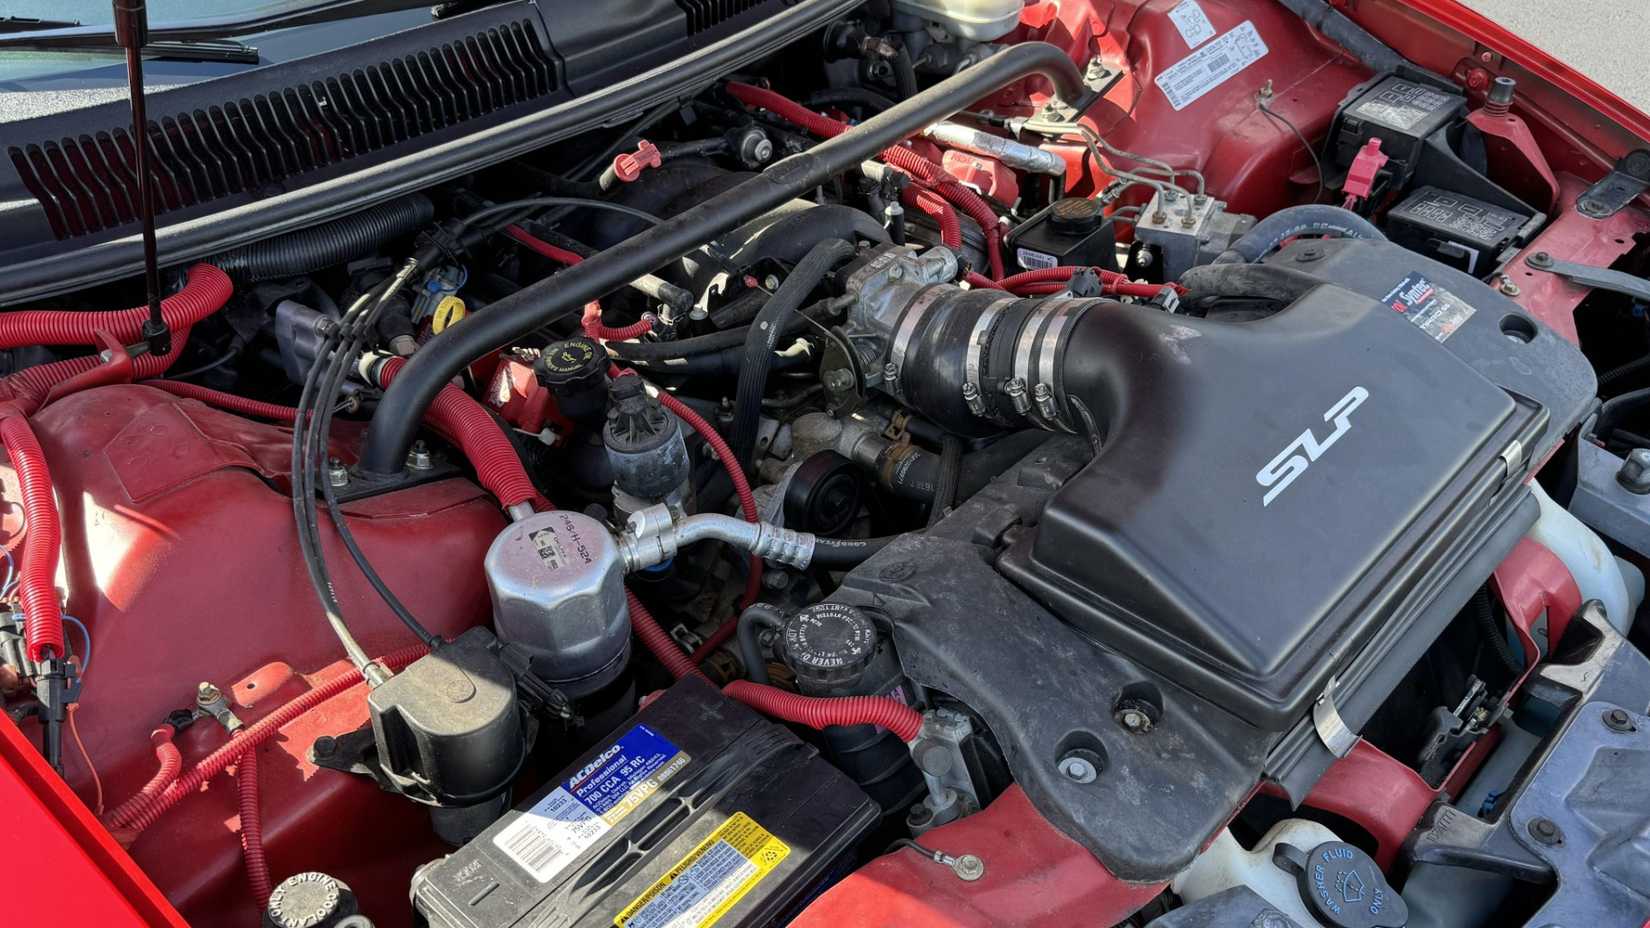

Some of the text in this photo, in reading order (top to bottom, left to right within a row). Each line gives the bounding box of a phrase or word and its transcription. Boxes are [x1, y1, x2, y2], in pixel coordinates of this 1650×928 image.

[1256, 386, 1368, 507] SLP
[811, 657, 843, 666] NEVER
[569, 744, 621, 789] ACDelco
[577, 754, 627, 797] Professional
[584, 791, 602, 805] 700
[601, 774, 621, 793] CCA
[620, 763, 633, 777] 95
[630, 755, 645, 768] RC
[270, 872, 338, 928] ENGINE COOLANT ONLY
[1314, 847, 1384, 915] WASHER FLUID ONLY
